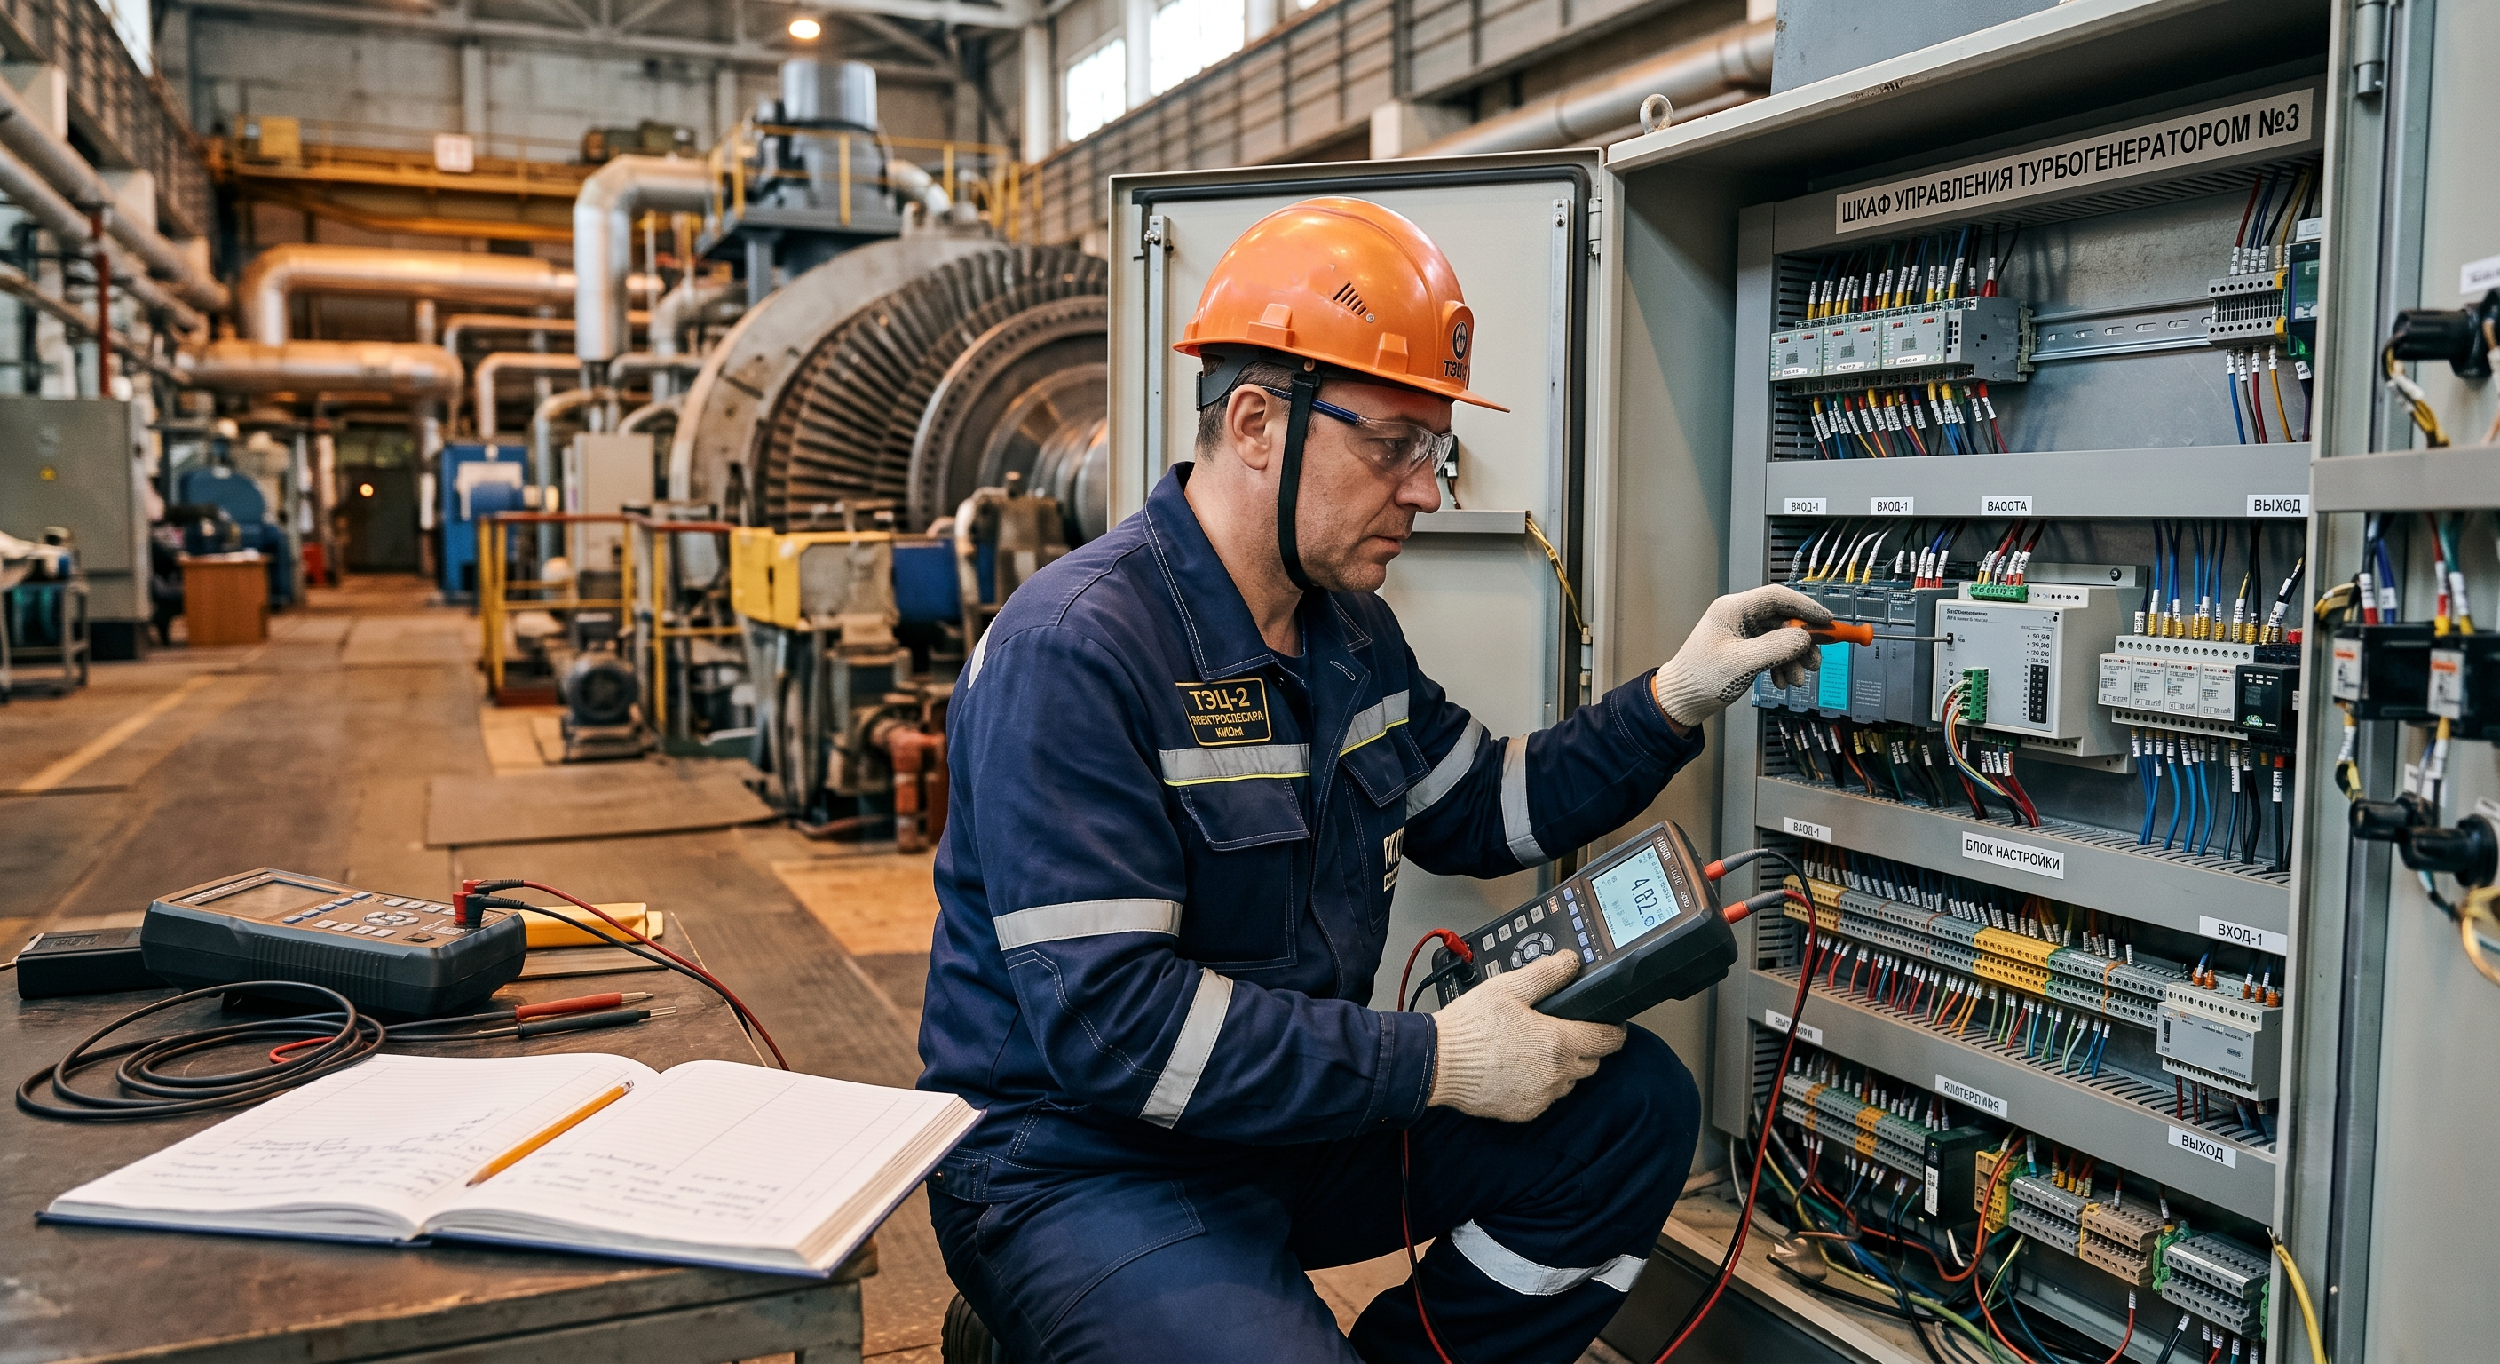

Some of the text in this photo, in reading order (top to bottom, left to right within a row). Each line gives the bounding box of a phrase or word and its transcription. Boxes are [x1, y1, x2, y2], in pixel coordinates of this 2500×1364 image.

[1843, 103, 2299, 223] ШКАФ УПРАВЛЕНИЯ ТУРБОГЕНЕРАТОРОМ №3
[2254, 499, 2301, 514] ВЫХОД
[1188, 687, 1250, 711] ТЭЦ-2
[1996, 845, 2060, 870] НАСТРОЙКИ
[2218, 923, 2262, 946] ВХОД-1
[2181, 1134, 2224, 1163] ВЫХОД
